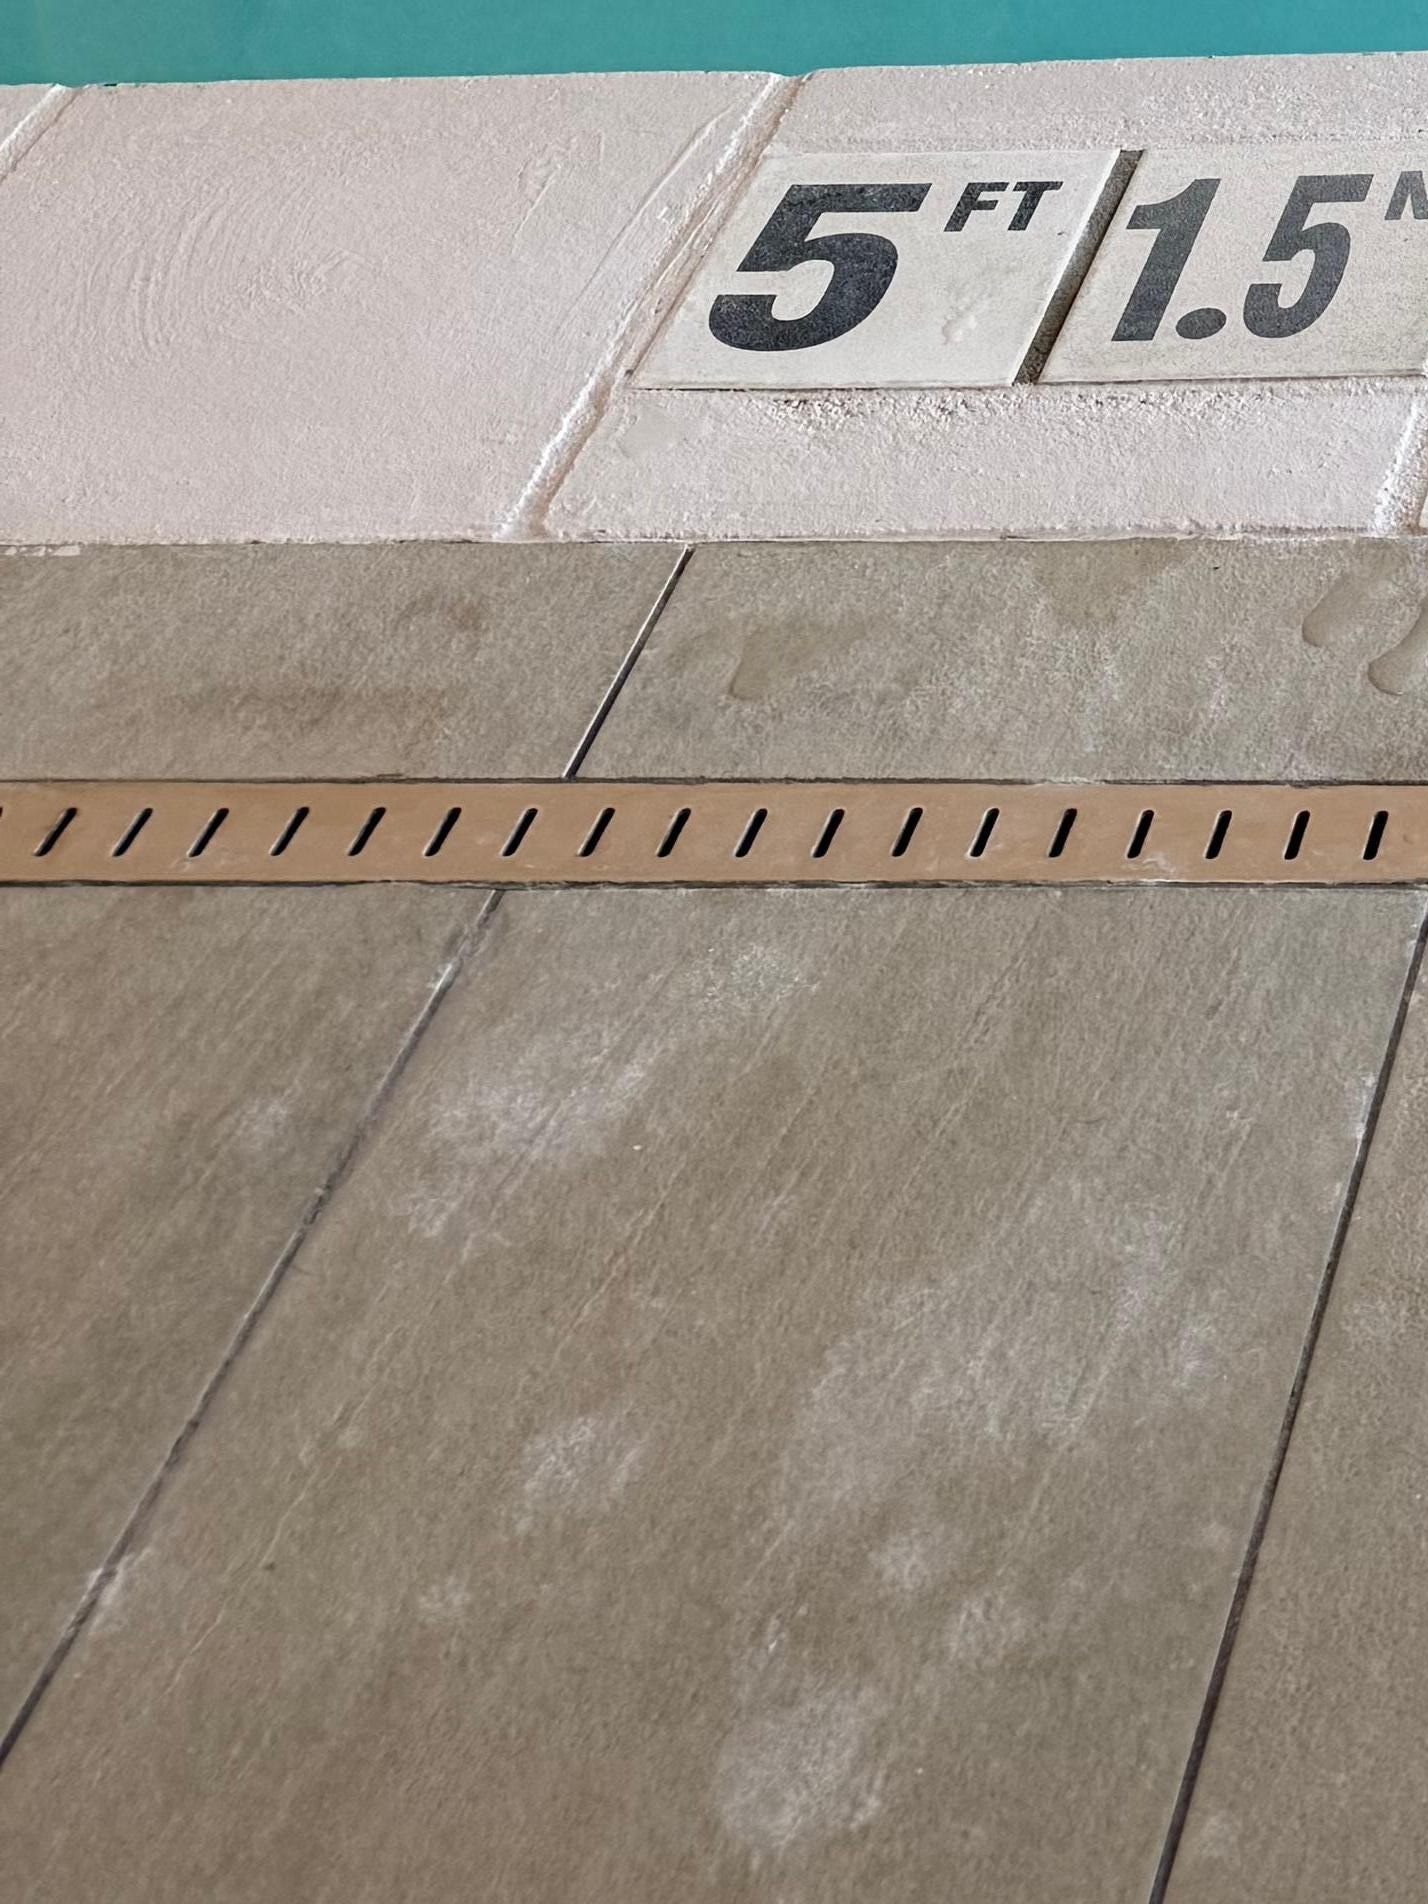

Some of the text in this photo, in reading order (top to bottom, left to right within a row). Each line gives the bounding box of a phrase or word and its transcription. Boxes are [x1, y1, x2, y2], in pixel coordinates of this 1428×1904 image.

[708, 179, 1065, 351] 5 FT
[1113, 172, 1374, 343] 1.5
